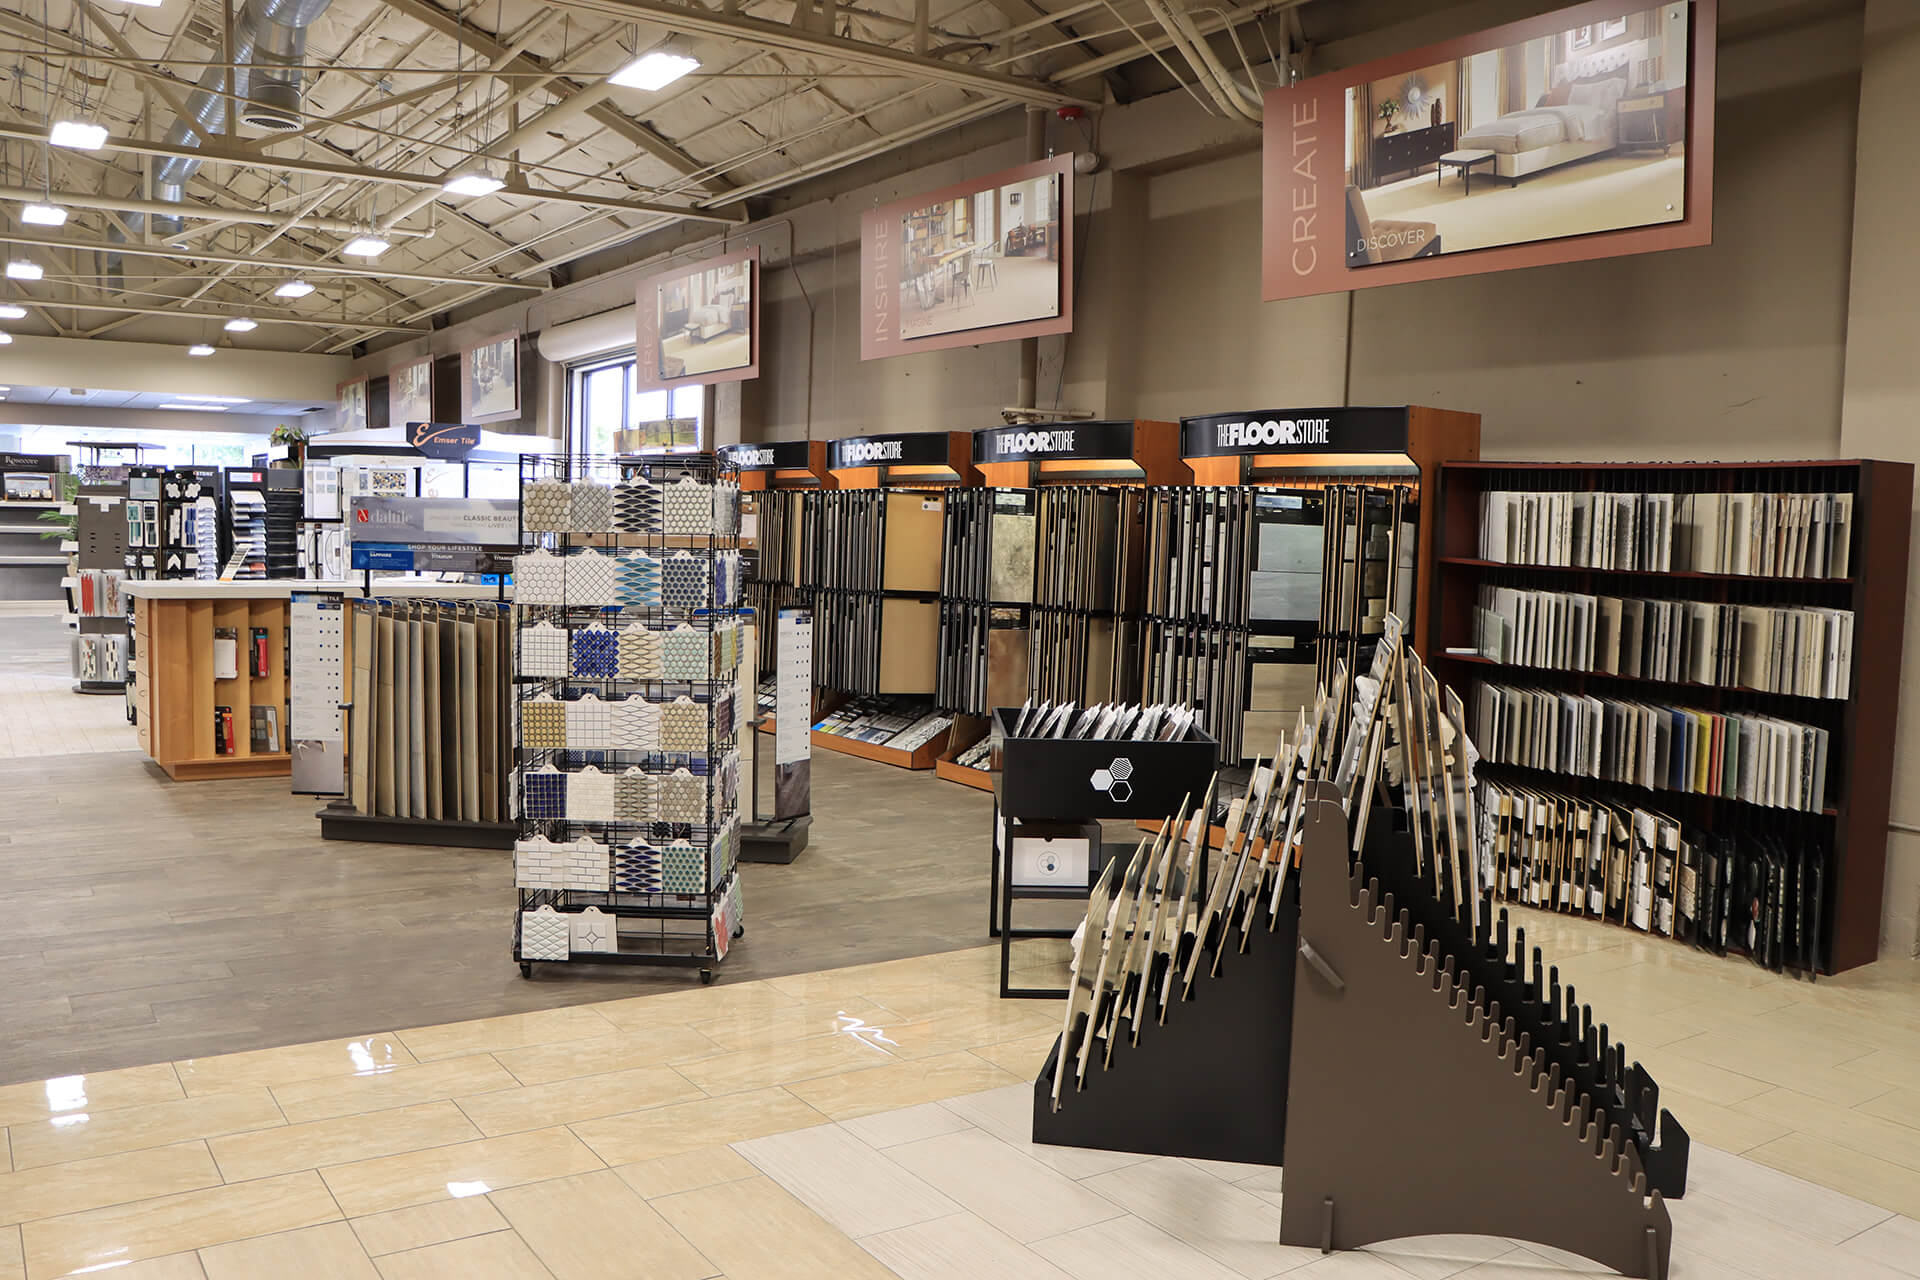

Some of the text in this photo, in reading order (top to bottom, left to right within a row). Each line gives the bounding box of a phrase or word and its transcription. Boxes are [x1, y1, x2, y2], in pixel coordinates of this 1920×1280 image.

[1292, 98, 1317, 276] CREATE
[1357, 229, 1425, 252] DISCOVER
[875, 219, 888, 341] INSPIRE
[433, 437, 477, 445] Emser Tile
